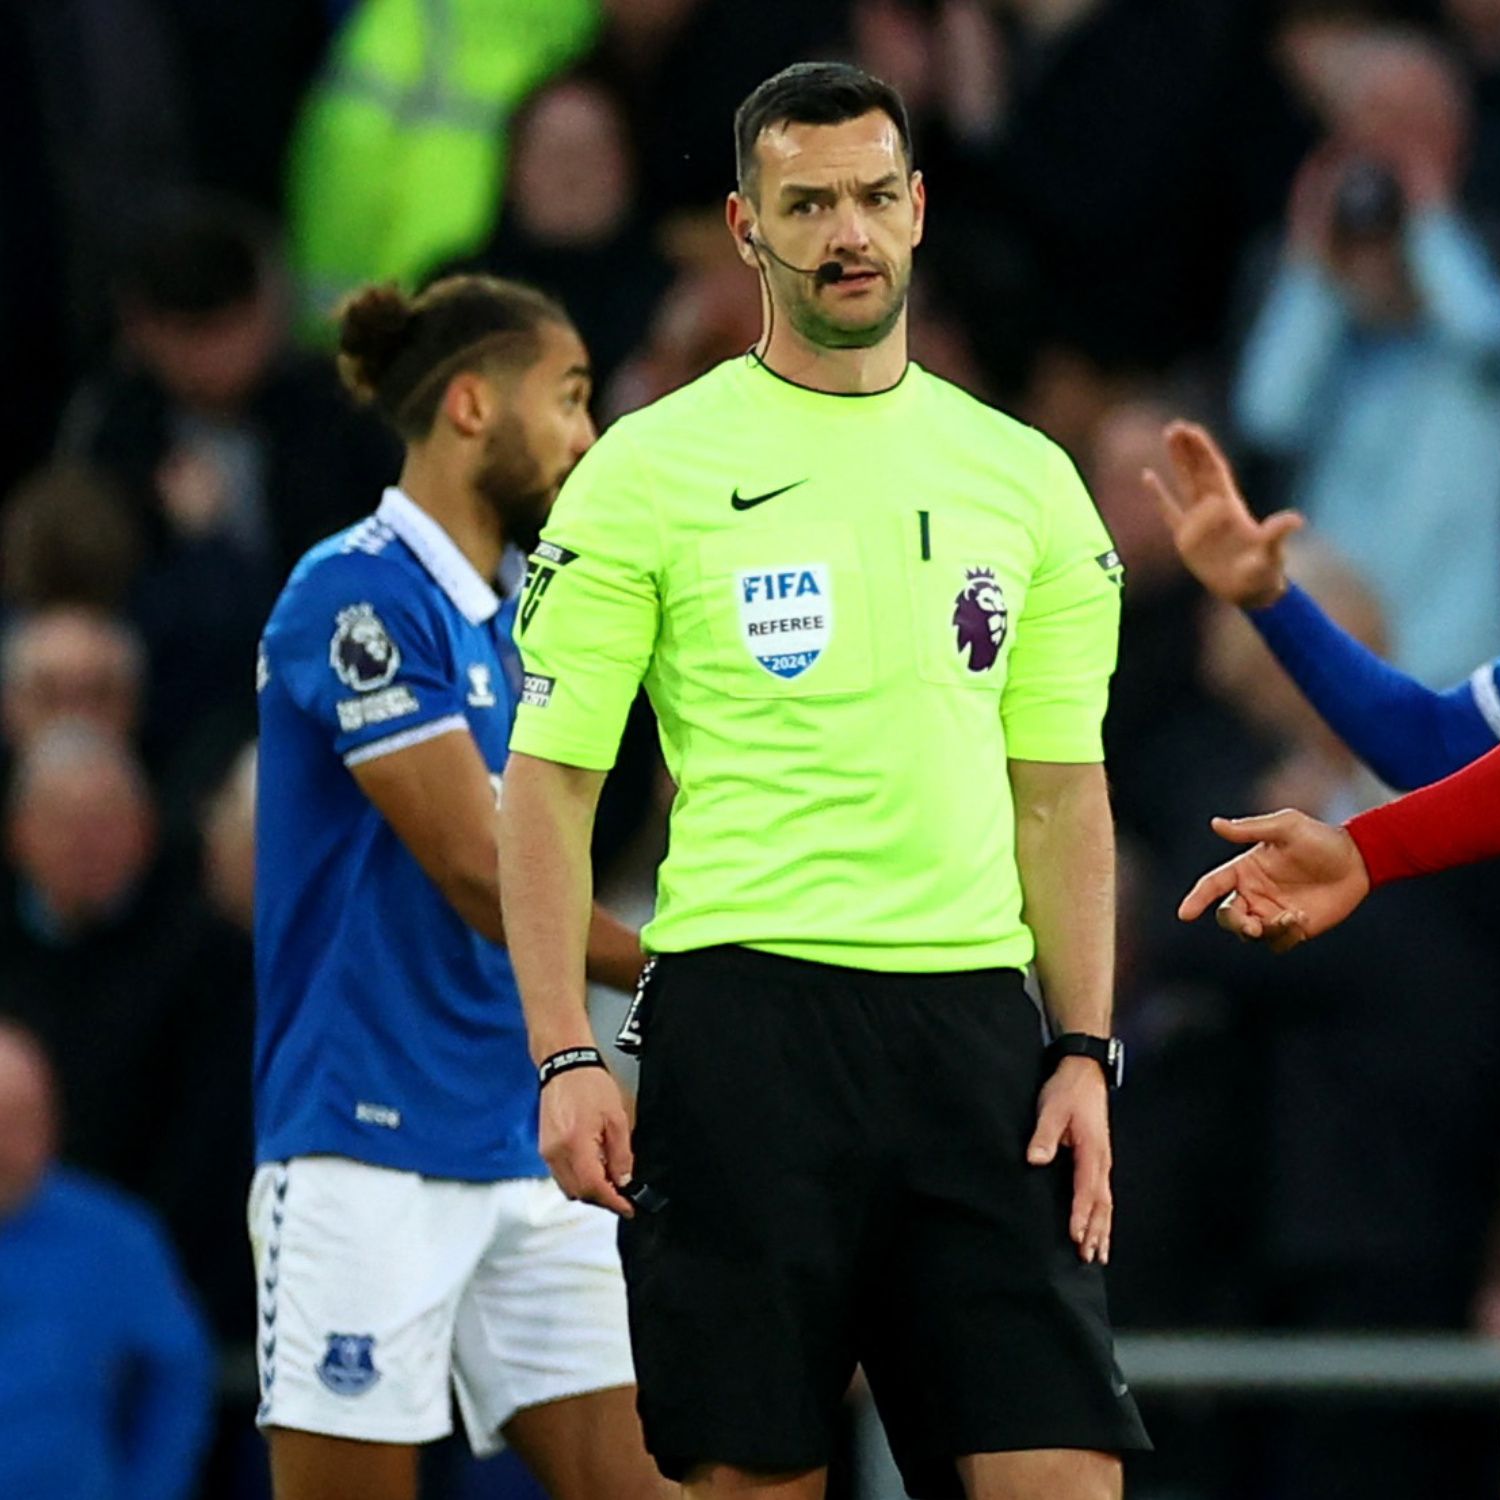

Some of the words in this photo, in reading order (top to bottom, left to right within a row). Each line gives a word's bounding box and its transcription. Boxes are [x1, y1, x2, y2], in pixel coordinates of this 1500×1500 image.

[743, 570, 821, 603] FIFA
[747, 614, 824, 637] REFEREE
[771, 654, 807, 671] 2024
